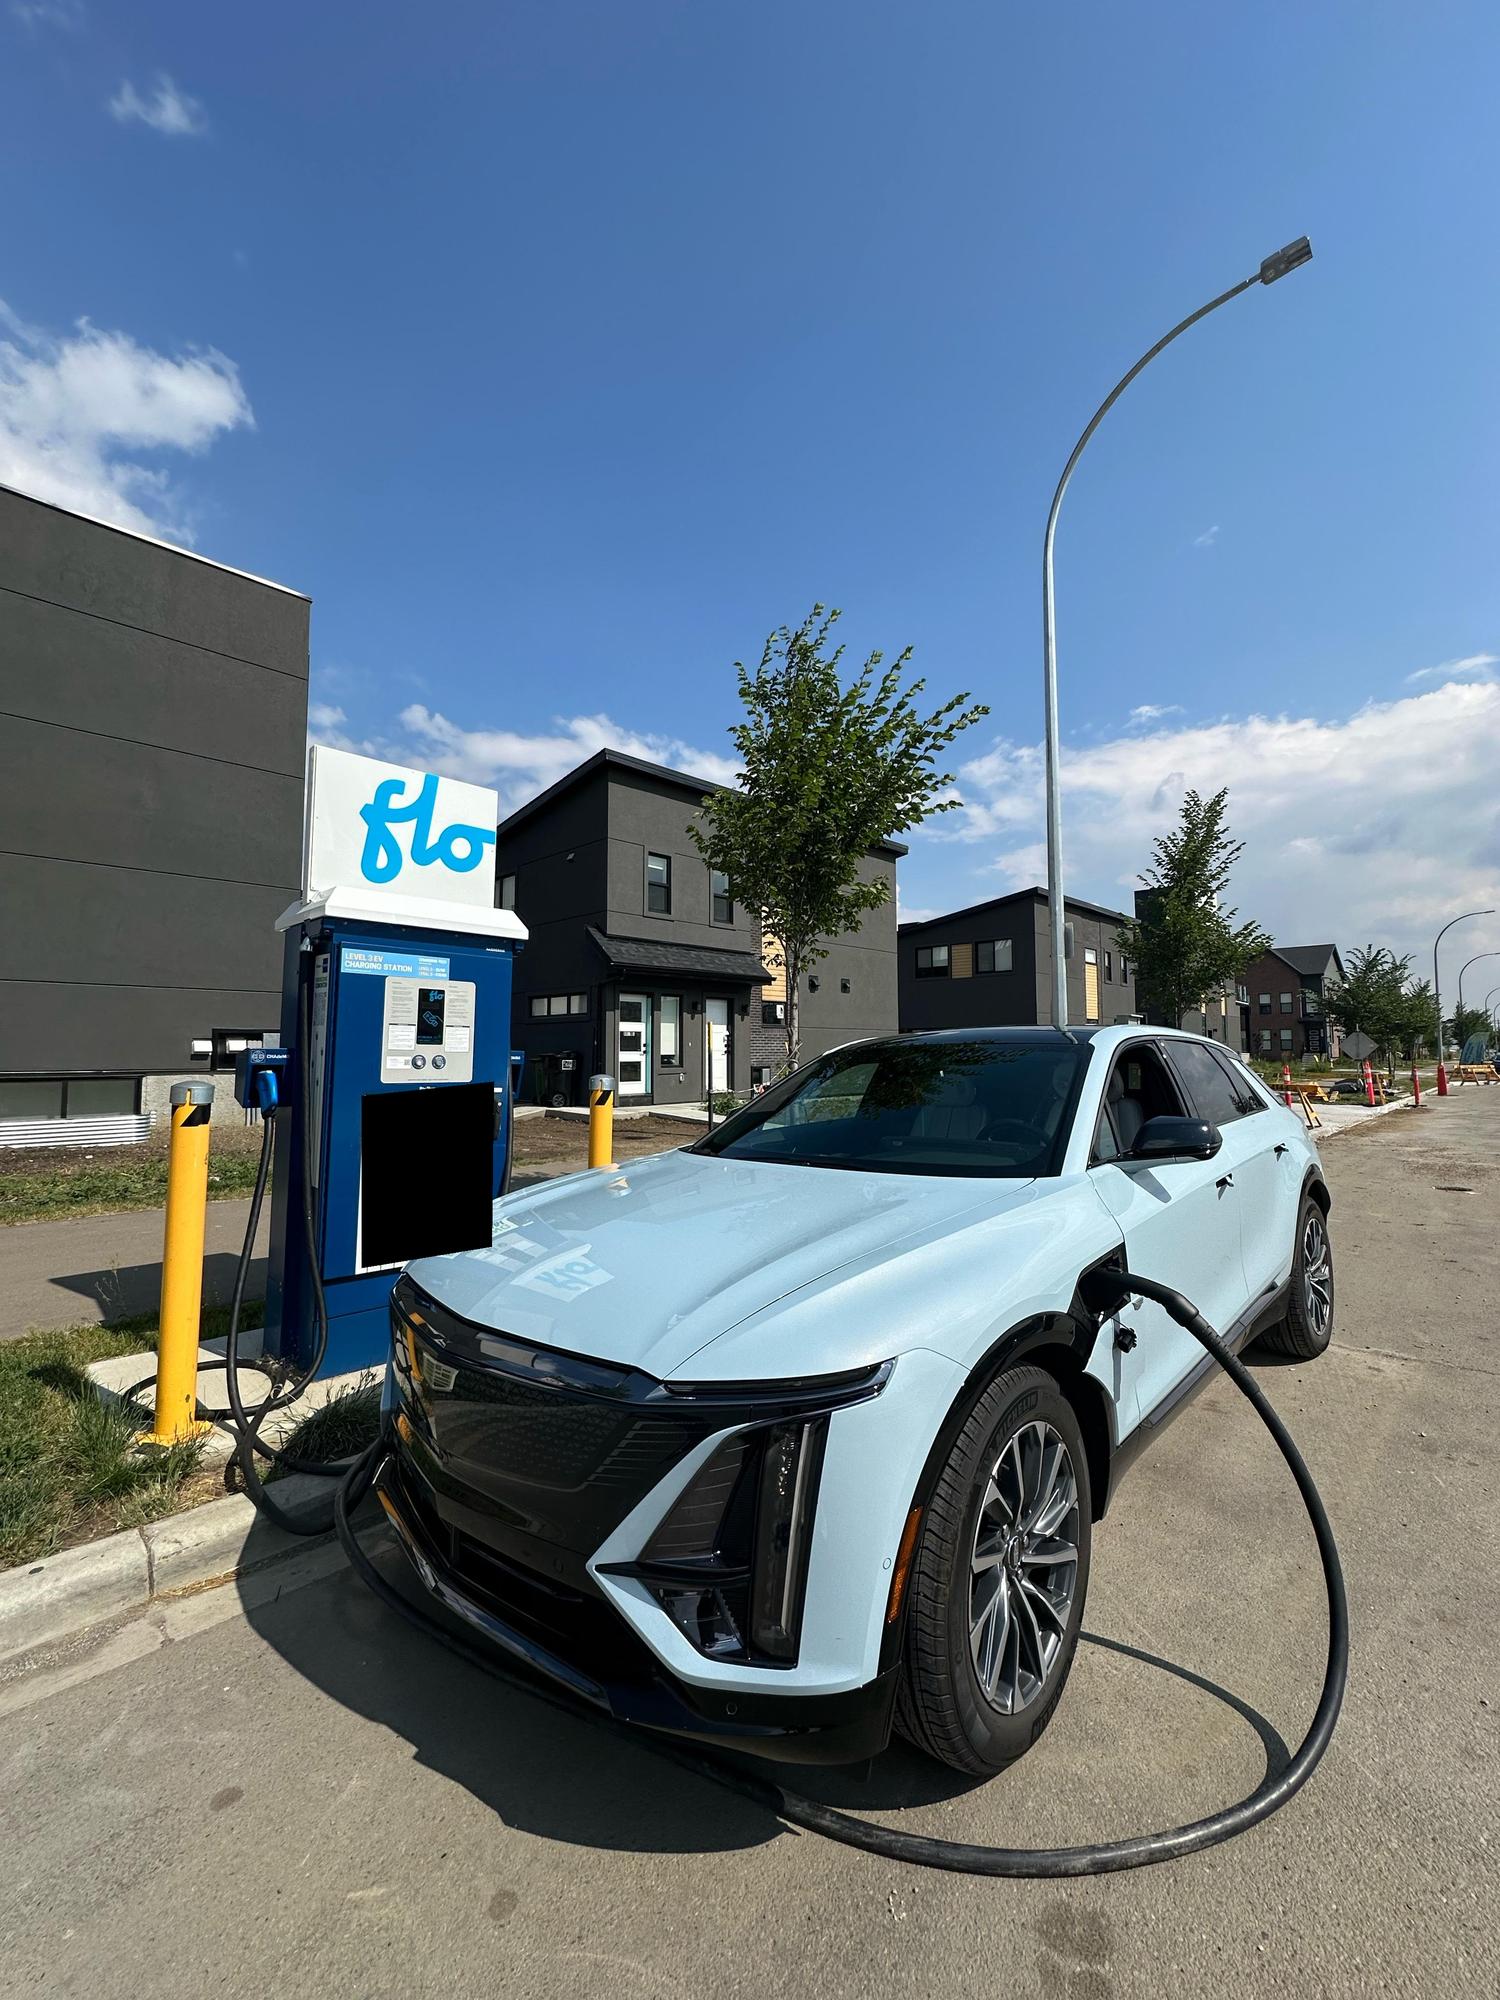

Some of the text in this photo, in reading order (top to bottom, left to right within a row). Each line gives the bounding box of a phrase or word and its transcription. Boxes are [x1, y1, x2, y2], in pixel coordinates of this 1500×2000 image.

[359, 773, 496, 884] flo
[345, 952, 366, 961] LEVEL
[374, 955, 384, 963] EV
[345, 960, 382, 970] CHARGING
[384, 963, 413, 972] STATION
[429, 990, 444, 1002] flo
